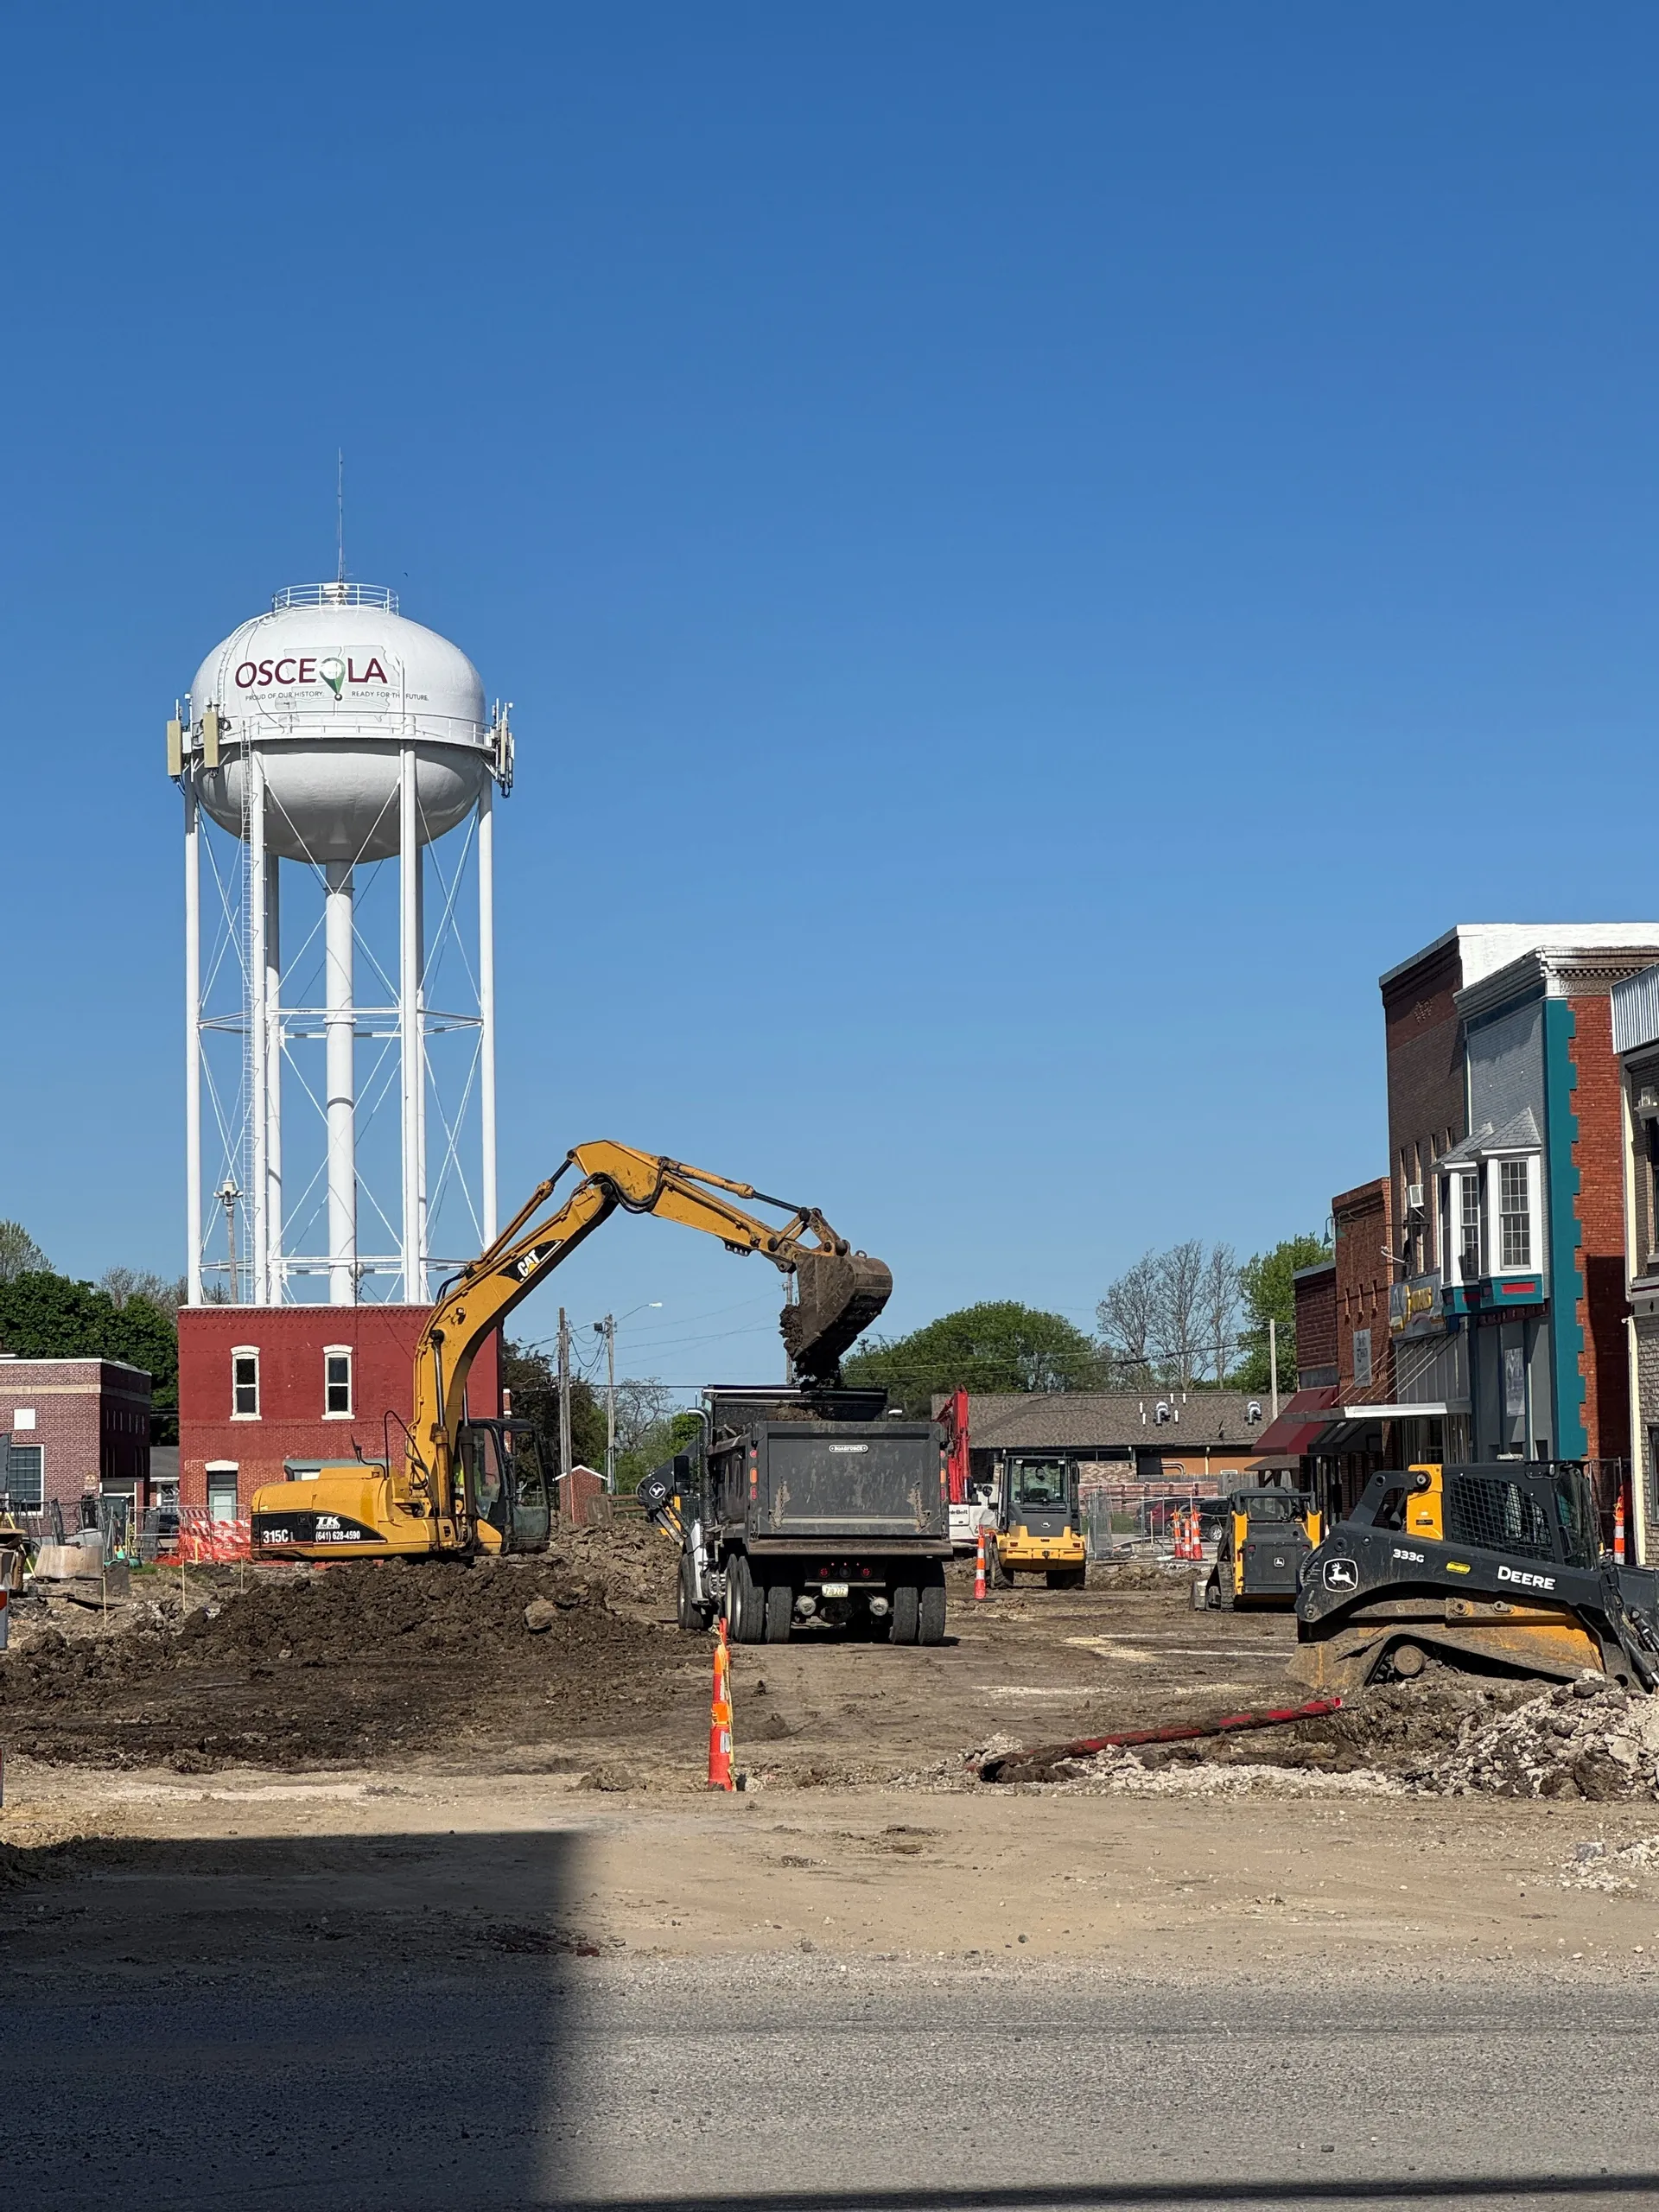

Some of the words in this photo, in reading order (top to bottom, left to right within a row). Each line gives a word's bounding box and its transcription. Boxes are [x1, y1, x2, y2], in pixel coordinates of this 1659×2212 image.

[518, 1249, 540, 1277] CAT
[315, 1516, 340, 1525] TK
[263, 1529, 289, 1543] 315C
[289, 1532, 296, 1542] L
[315, 1531, 332, 1542] (641)
[332, 1530, 361, 1541] 628-4590
[1393, 1548, 1425, 1563] 333G
[1497, 1565, 1556, 1591] DEERE
